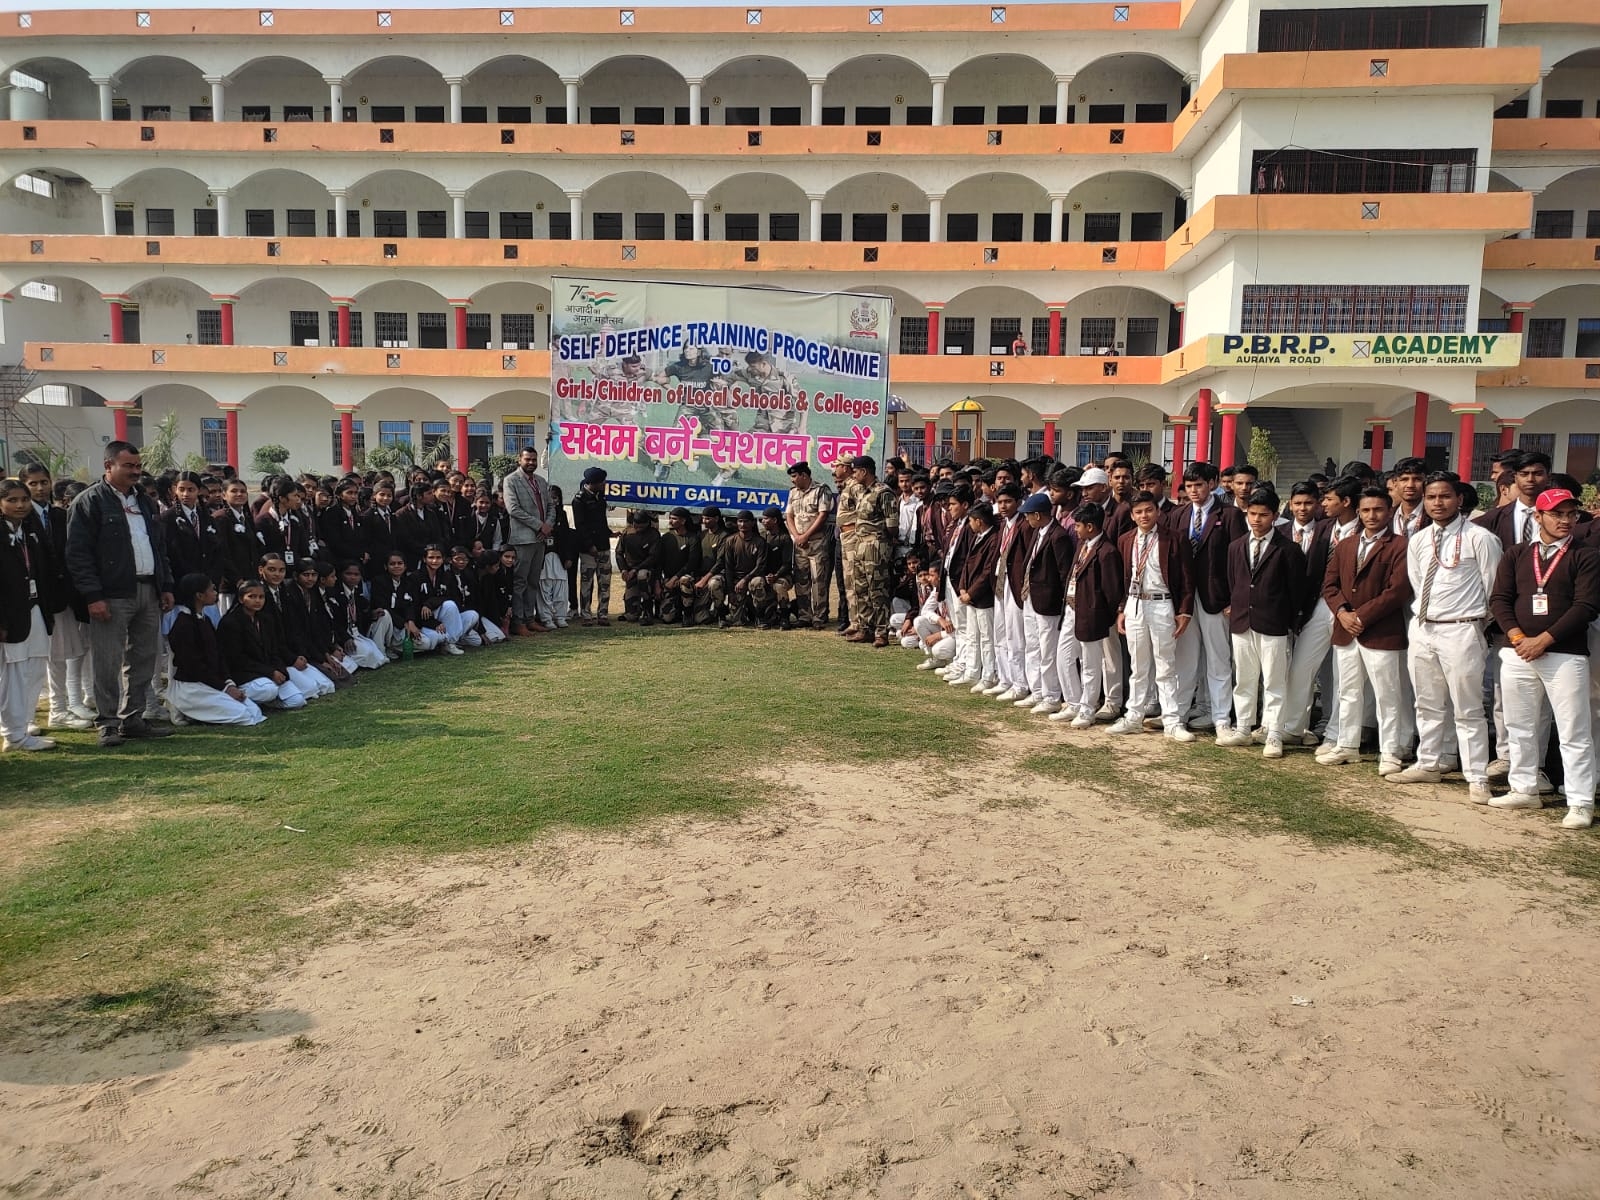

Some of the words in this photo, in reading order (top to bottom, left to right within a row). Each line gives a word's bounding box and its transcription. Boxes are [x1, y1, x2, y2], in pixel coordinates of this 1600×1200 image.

[573, 314, 593, 325] अमृत
[560, 336, 601, 360] SELF
[605, 324, 682, 357] DEFENCE
[687, 322, 768, 351] TRAINING
[773, 332, 879, 378] PROGRAMME
[1223, 335, 1336, 354] P.B.R.P.
[1371, 335, 1498, 354] ACADEMY
[712, 358, 731, 373] TO
[556, 378, 662, 403] Girls/Children
[667, 384, 683, 403] of
[687, 385, 728, 406] Local
[732, 387, 792, 410] Schools
[796, 391, 808, 412] &
[814, 392, 879, 418] Colleges
[559, 422, 638, 458] सक्षम
[604, 483, 631, 497] ISF
[636, 484, 680, 500] UNIT
[685, 488, 731, 505] GAIL,
